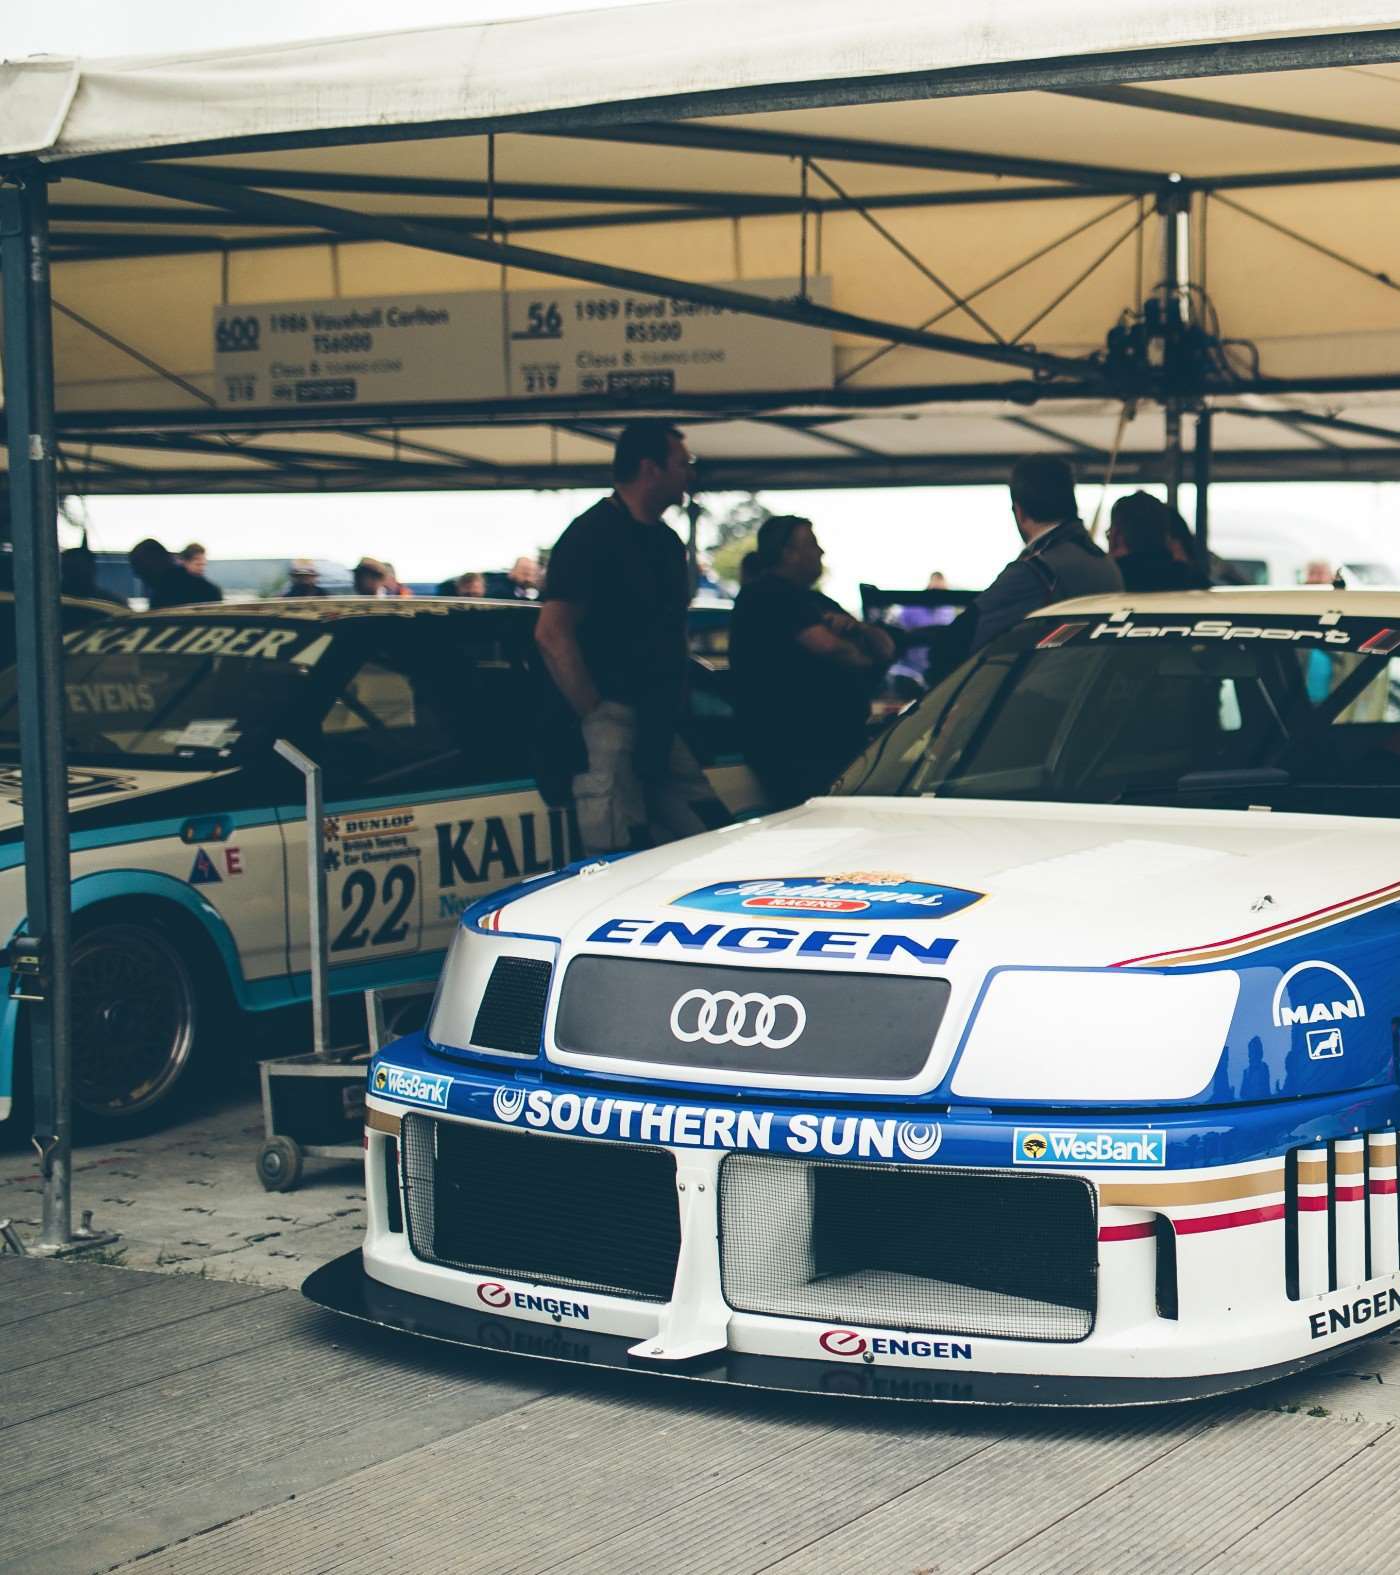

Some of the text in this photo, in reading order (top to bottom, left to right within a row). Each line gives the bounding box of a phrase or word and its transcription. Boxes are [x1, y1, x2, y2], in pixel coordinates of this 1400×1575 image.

[528, 302, 562, 334] 56
[576, 299, 620, 320] 1989
[624, 298, 666, 318] Ford
[217, 315, 260, 347] 600
[67, 625, 298, 658] KALIBER
[1089, 620, 1351, 645] HanSport
[65, 682, 156, 713] EVENS
[346, 815, 415, 832] DUNLOP
[225, 848, 243, 874] E
[331, 863, 416, 952] 22
[714, 880, 944, 907] Rothmans
[768, 897, 842, 910] RACING
[586, 918, 960, 966] ENGEN
[1281, 998, 1358, 1026] MAN
[387, 1066, 445, 1103] WesBank
[524, 1088, 901, 1158] SOUTHERN SUN
[1049, 1131, 1161, 1164] WesBank
[514, 1291, 590, 1320] ENGEN
[872, 1338, 972, 1360] ENGEN
